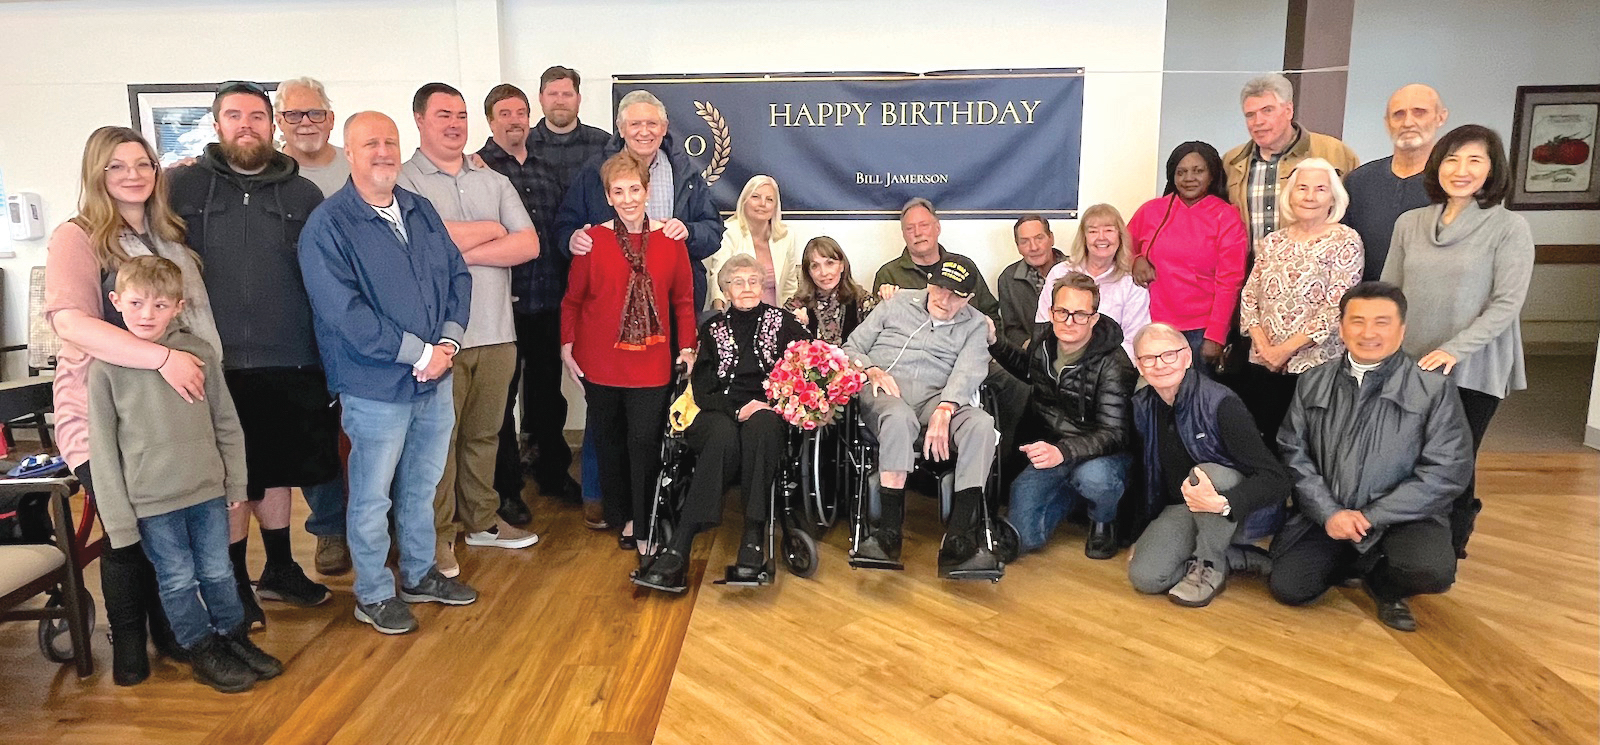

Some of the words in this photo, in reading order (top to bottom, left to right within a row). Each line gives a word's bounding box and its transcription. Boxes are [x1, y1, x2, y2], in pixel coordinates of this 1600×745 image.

[769, 102, 872, 127] HAPPY
[880, 100, 1041, 126] BIRTHDAY
[856, 172, 883, 184] BILL
[884, 171, 949, 187] JAMERSON
